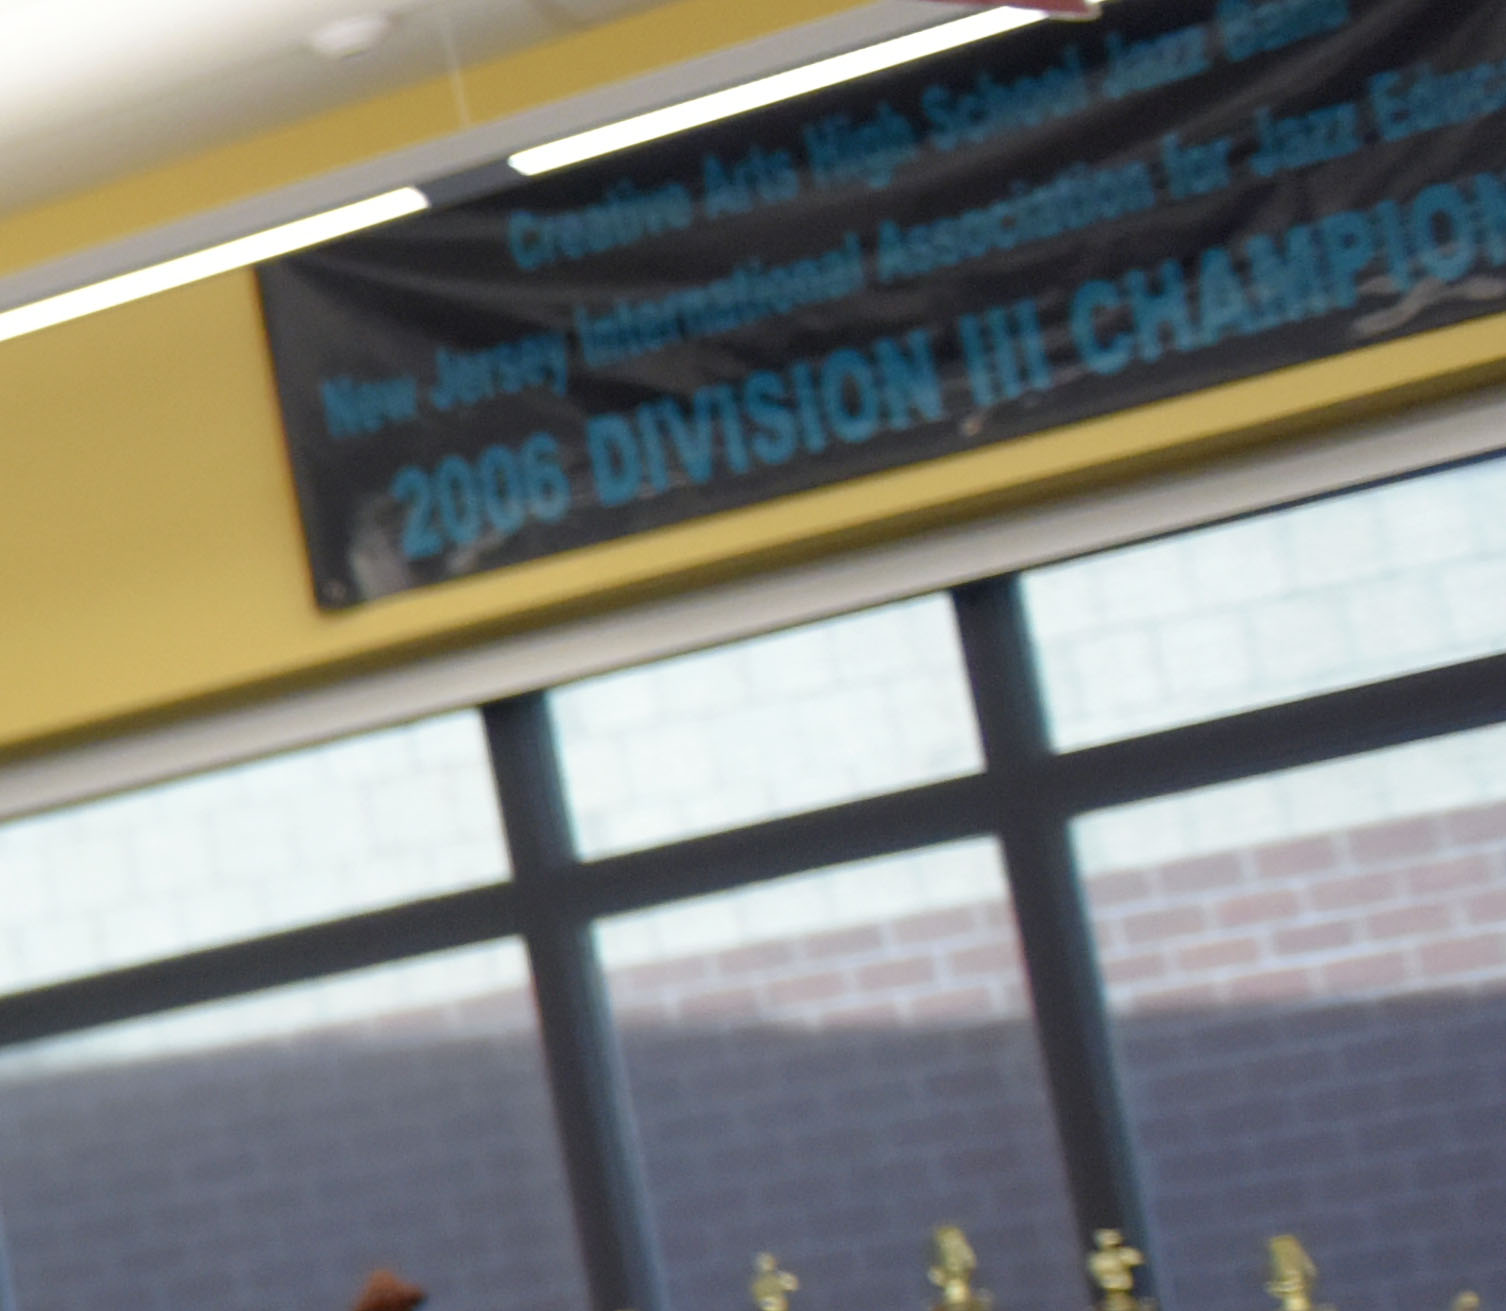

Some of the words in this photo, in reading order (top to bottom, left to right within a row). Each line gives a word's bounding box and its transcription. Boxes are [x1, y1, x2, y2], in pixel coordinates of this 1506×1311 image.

[703, 145, 798, 217] Arts
[804, 105, 917, 189] High
[921, 45, 1082, 152] School
[1104, 27, 1211, 98] Jazz
[323, 374, 417, 438] New
[433, 332, 567, 410] Jersey
[574, 232, 865, 367] International
[877, 161, 1156, 282] Association
[1162, 131, 1232, 199] for
[1249, 103, 1362, 176] Jazz
[392, 431, 572, 560] 2006
[585, 329, 943, 507] DIVISION
[958, 298, 1052, 407] III
